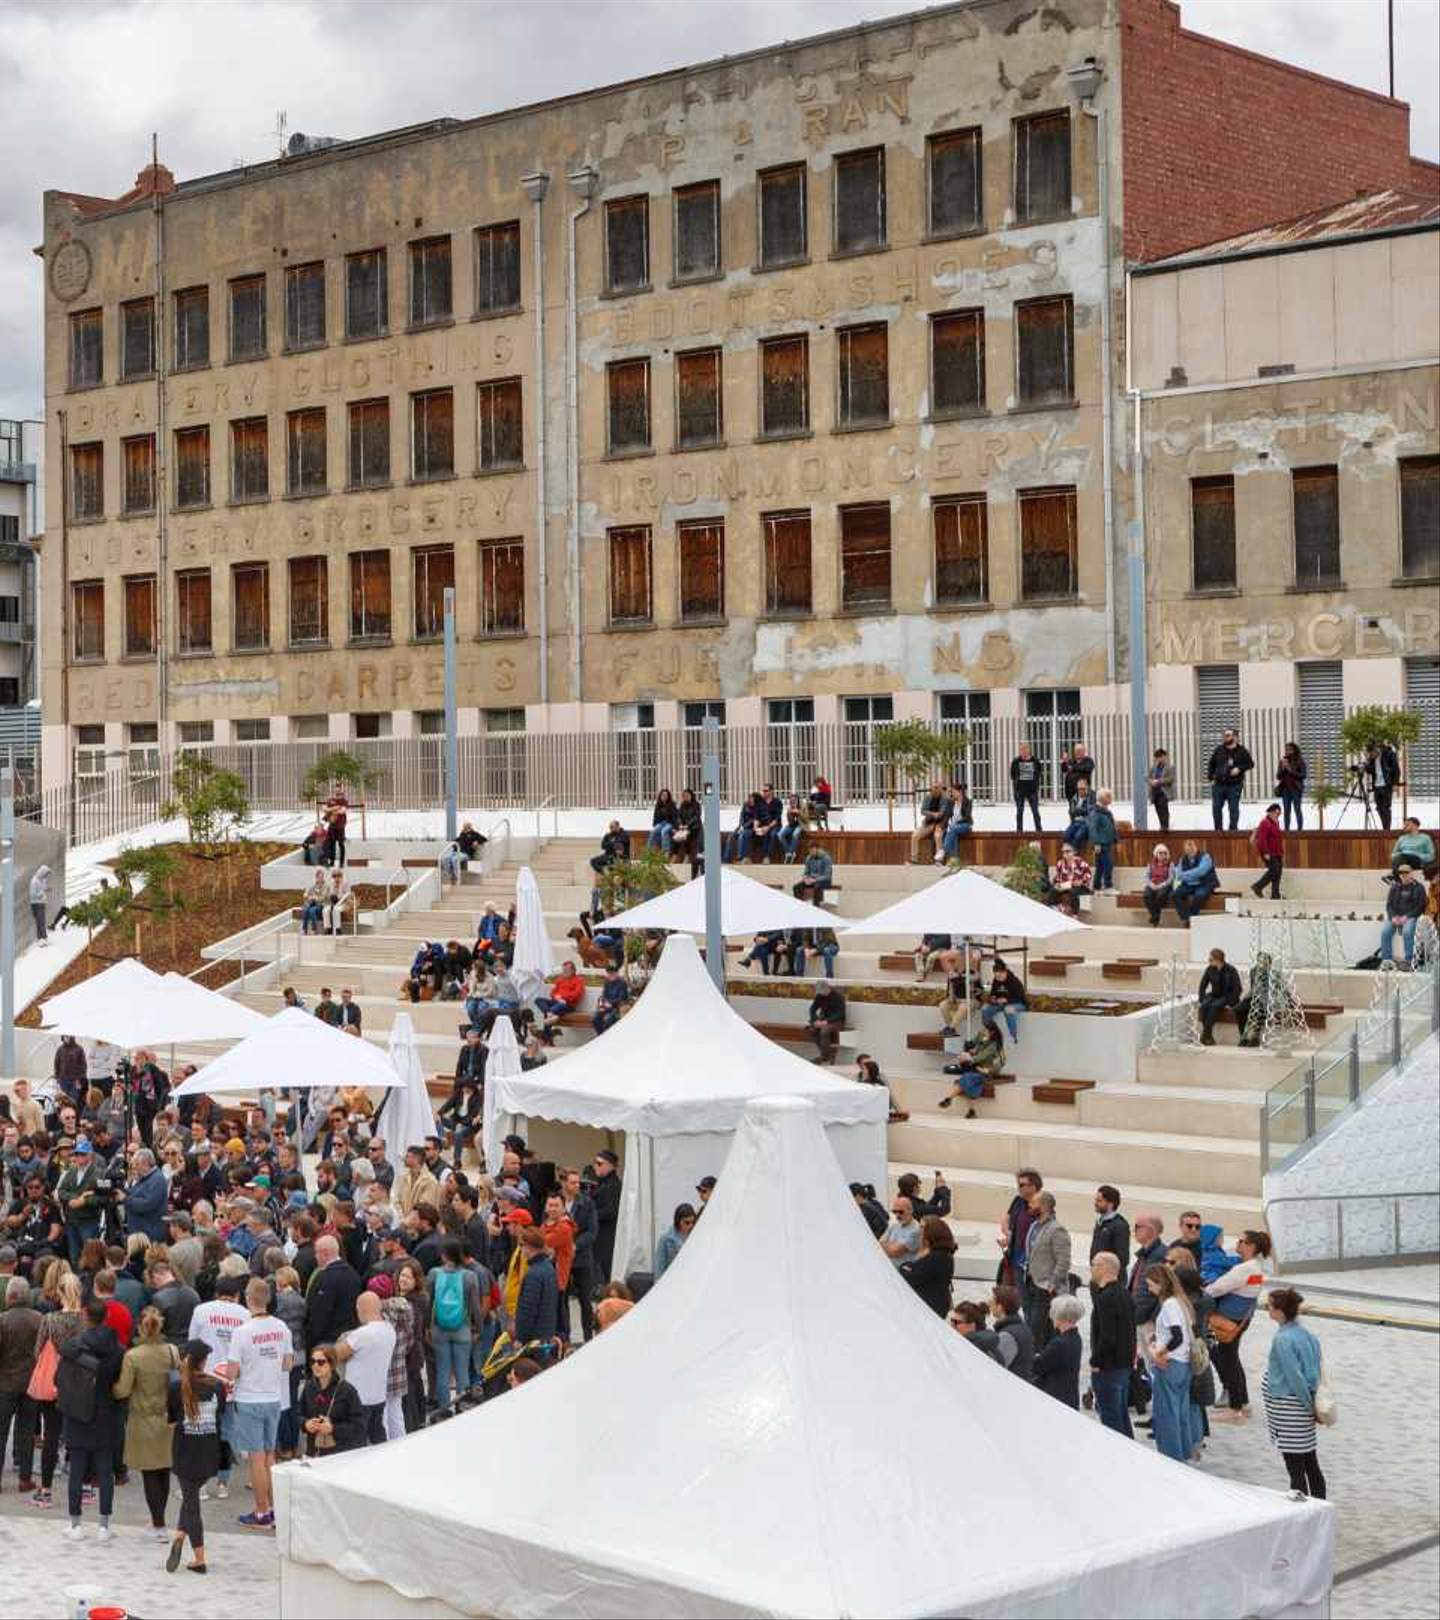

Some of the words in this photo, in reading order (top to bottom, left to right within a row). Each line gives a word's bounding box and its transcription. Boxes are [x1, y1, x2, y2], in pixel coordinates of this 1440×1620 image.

[74, 371, 260, 433] DRAERY
[294, 485, 515, 545] GROCERY
[1163, 608, 1440, 664] MERCER
[296, 656, 517, 702] CARPETS
